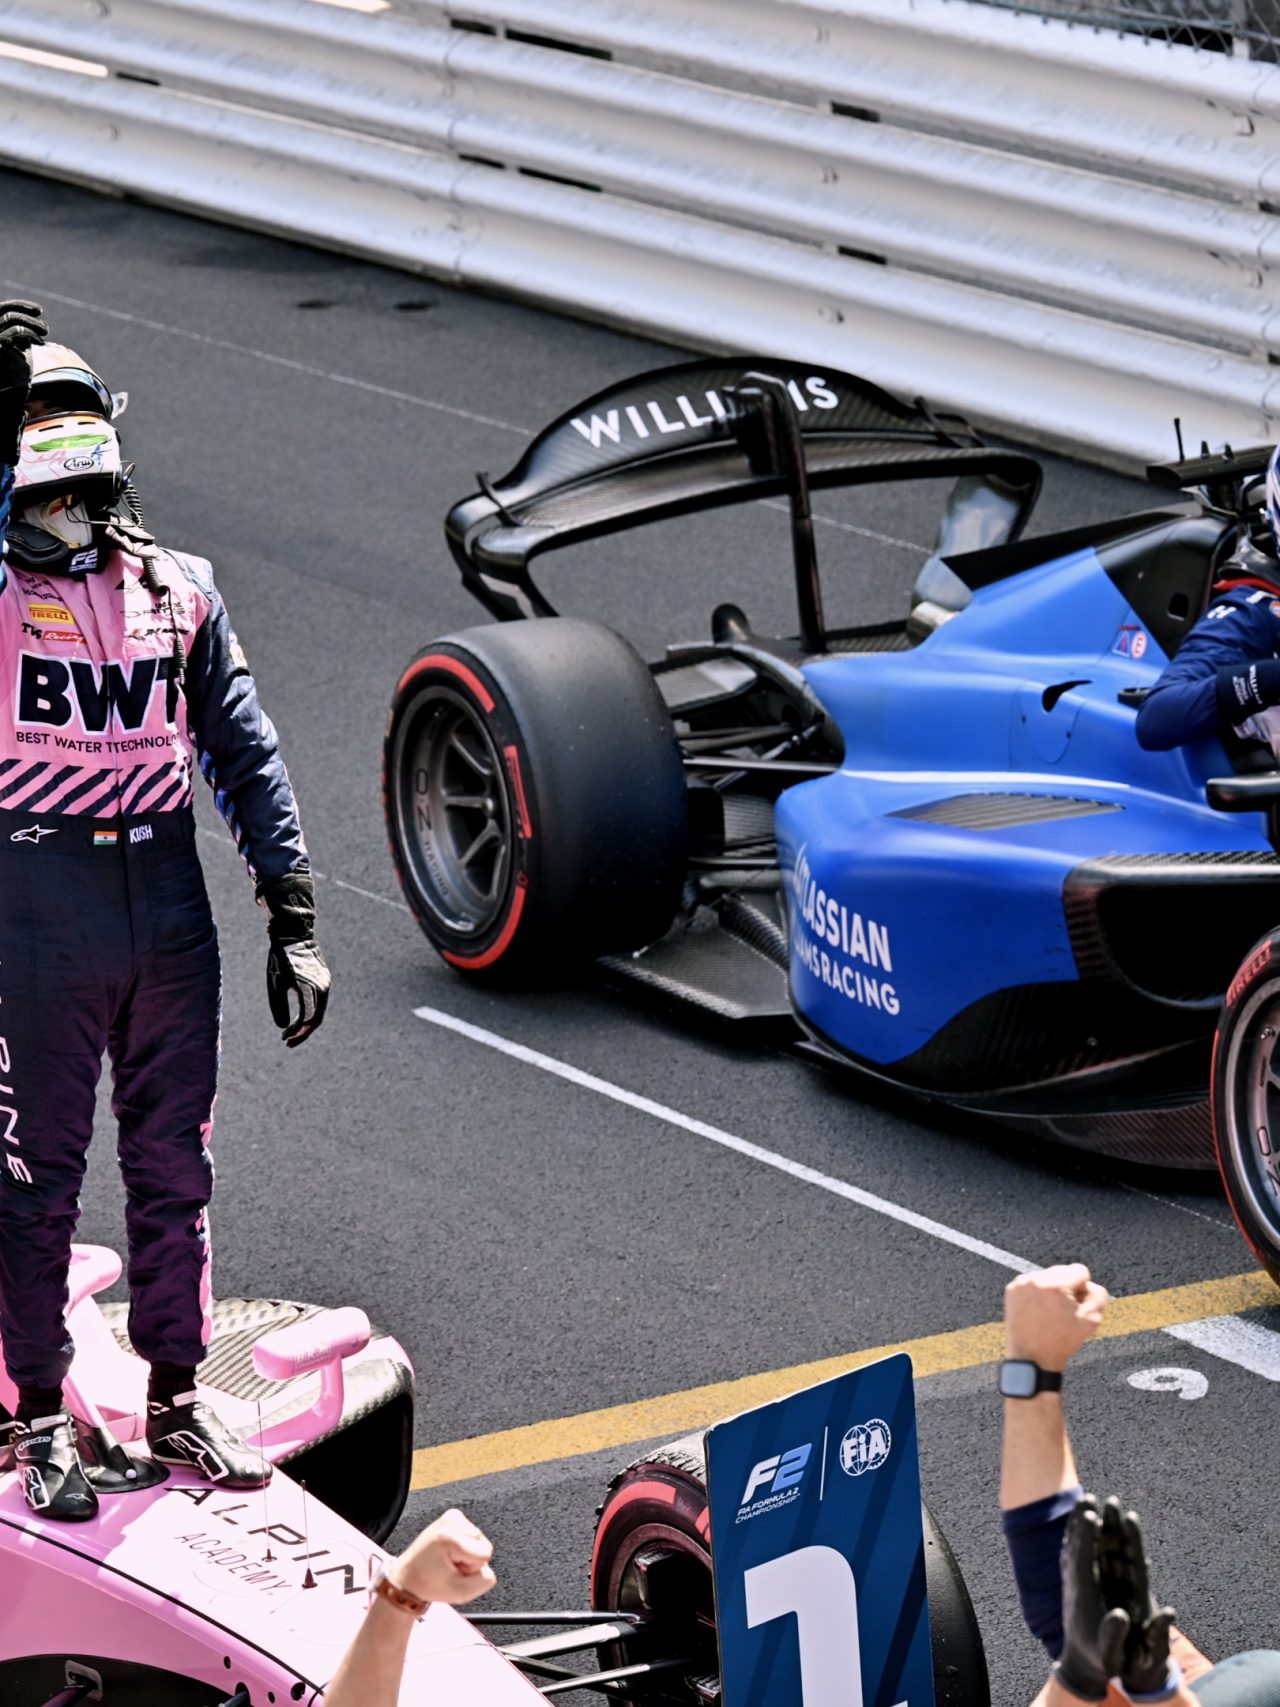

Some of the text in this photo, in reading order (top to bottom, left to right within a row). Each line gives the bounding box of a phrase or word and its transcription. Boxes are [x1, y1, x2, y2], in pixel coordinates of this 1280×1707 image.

[570, 376, 839, 448] WILLIS
[71, 547, 99, 566] F2
[16, 650, 182, 734] BWT
[16, 731, 50, 745] BEST
[54, 735, 102, 753] WATER
[129, 825, 153, 844] KUSH
[820, 951, 901, 1016] RACING
[737, 1487, 800, 1517] FIA FORMULA 2
[740, 1442, 813, 1506] F2
[163, 1487, 371, 1597] ALPIN
[174, 1532, 293, 1592] ACADEMY
[743, 1545, 909, 1707] 1
